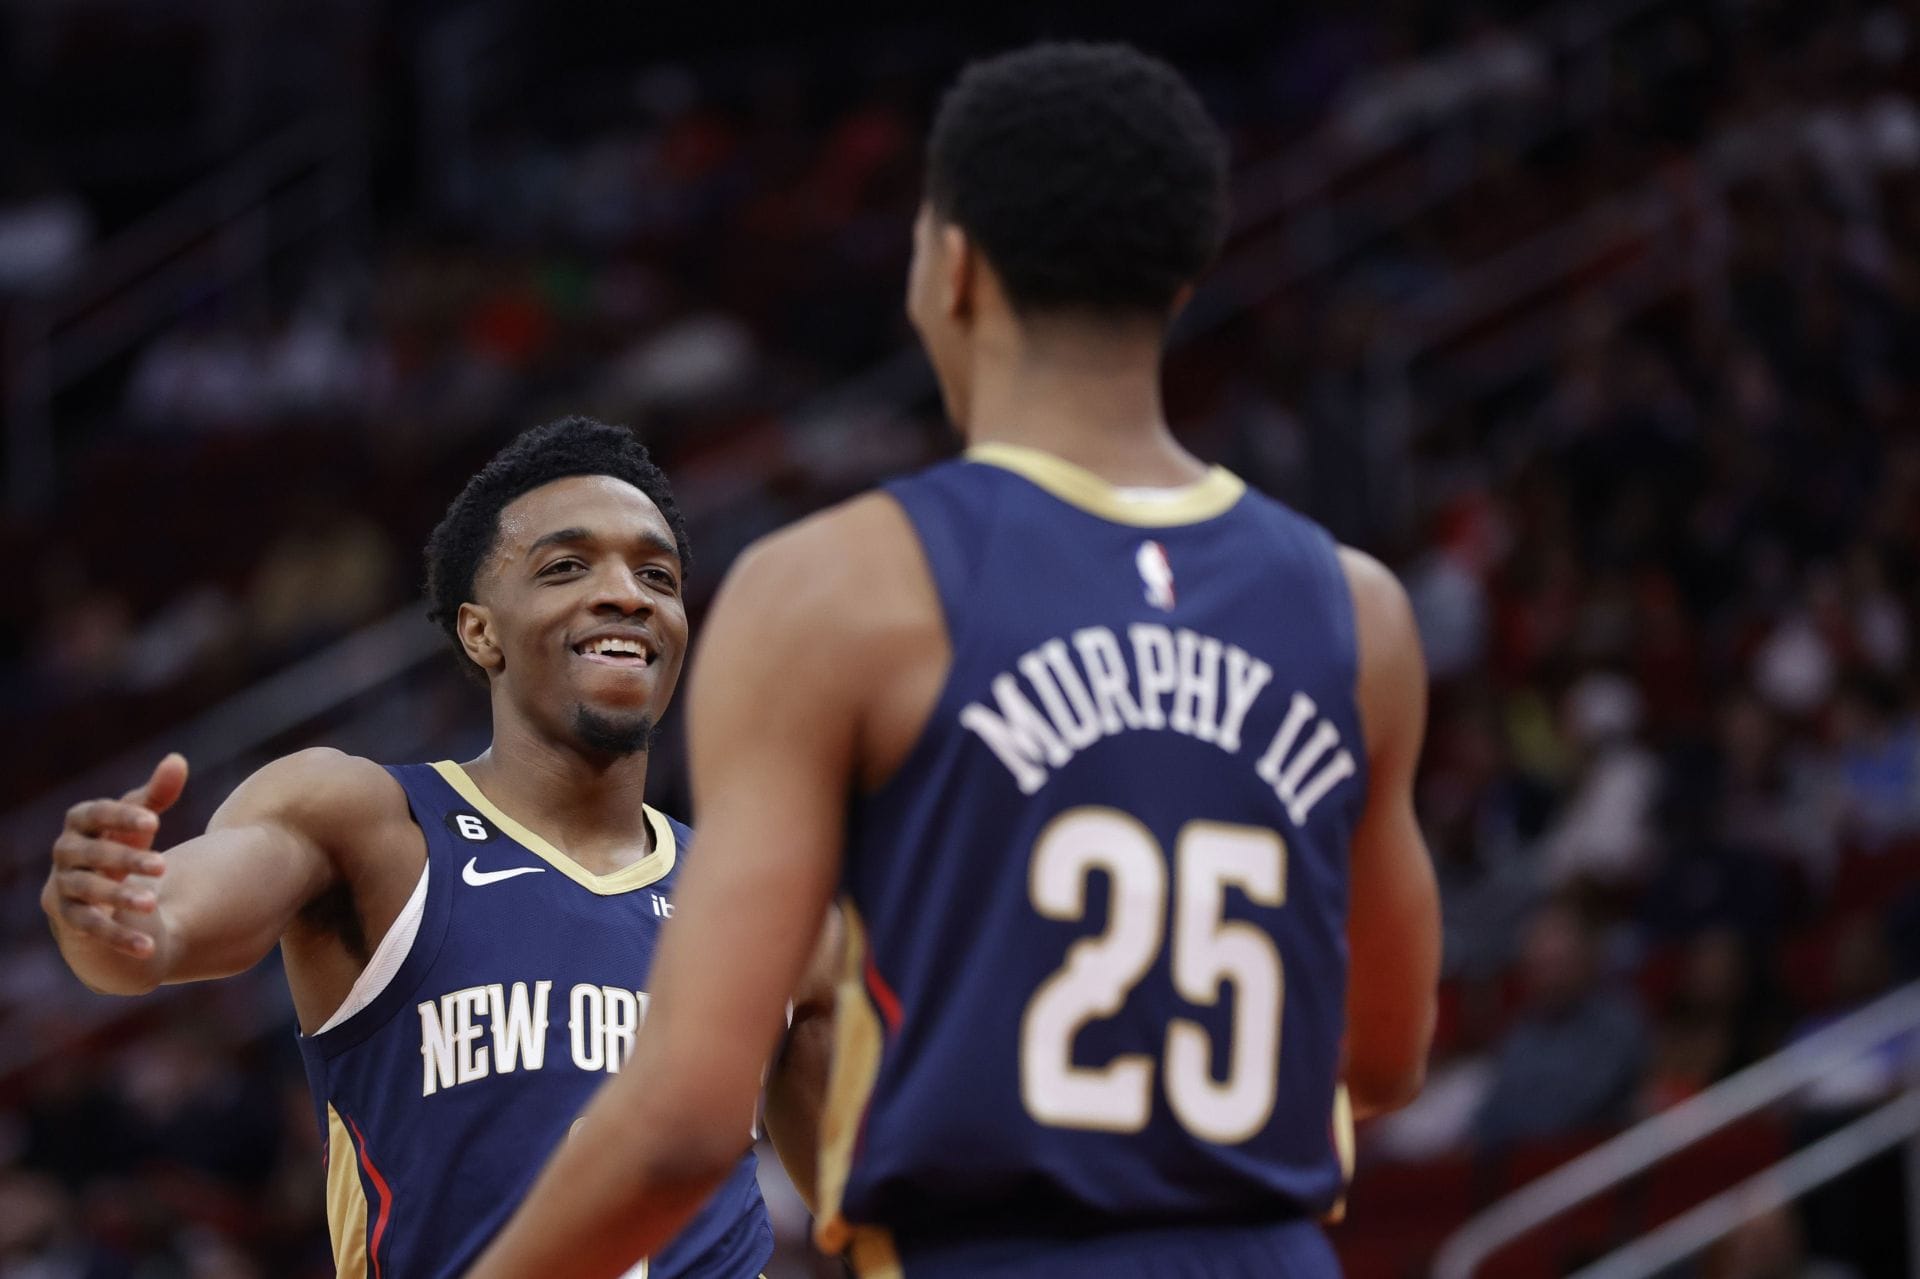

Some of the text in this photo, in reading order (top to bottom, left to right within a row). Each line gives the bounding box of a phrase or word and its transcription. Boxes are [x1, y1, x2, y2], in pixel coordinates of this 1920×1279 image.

[959, 622, 1357, 826] MURPHY III
[456, 814, 488, 840] 6
[417, 980, 552, 1097] NEW
[1018, 804, 1289, 1146] 25
